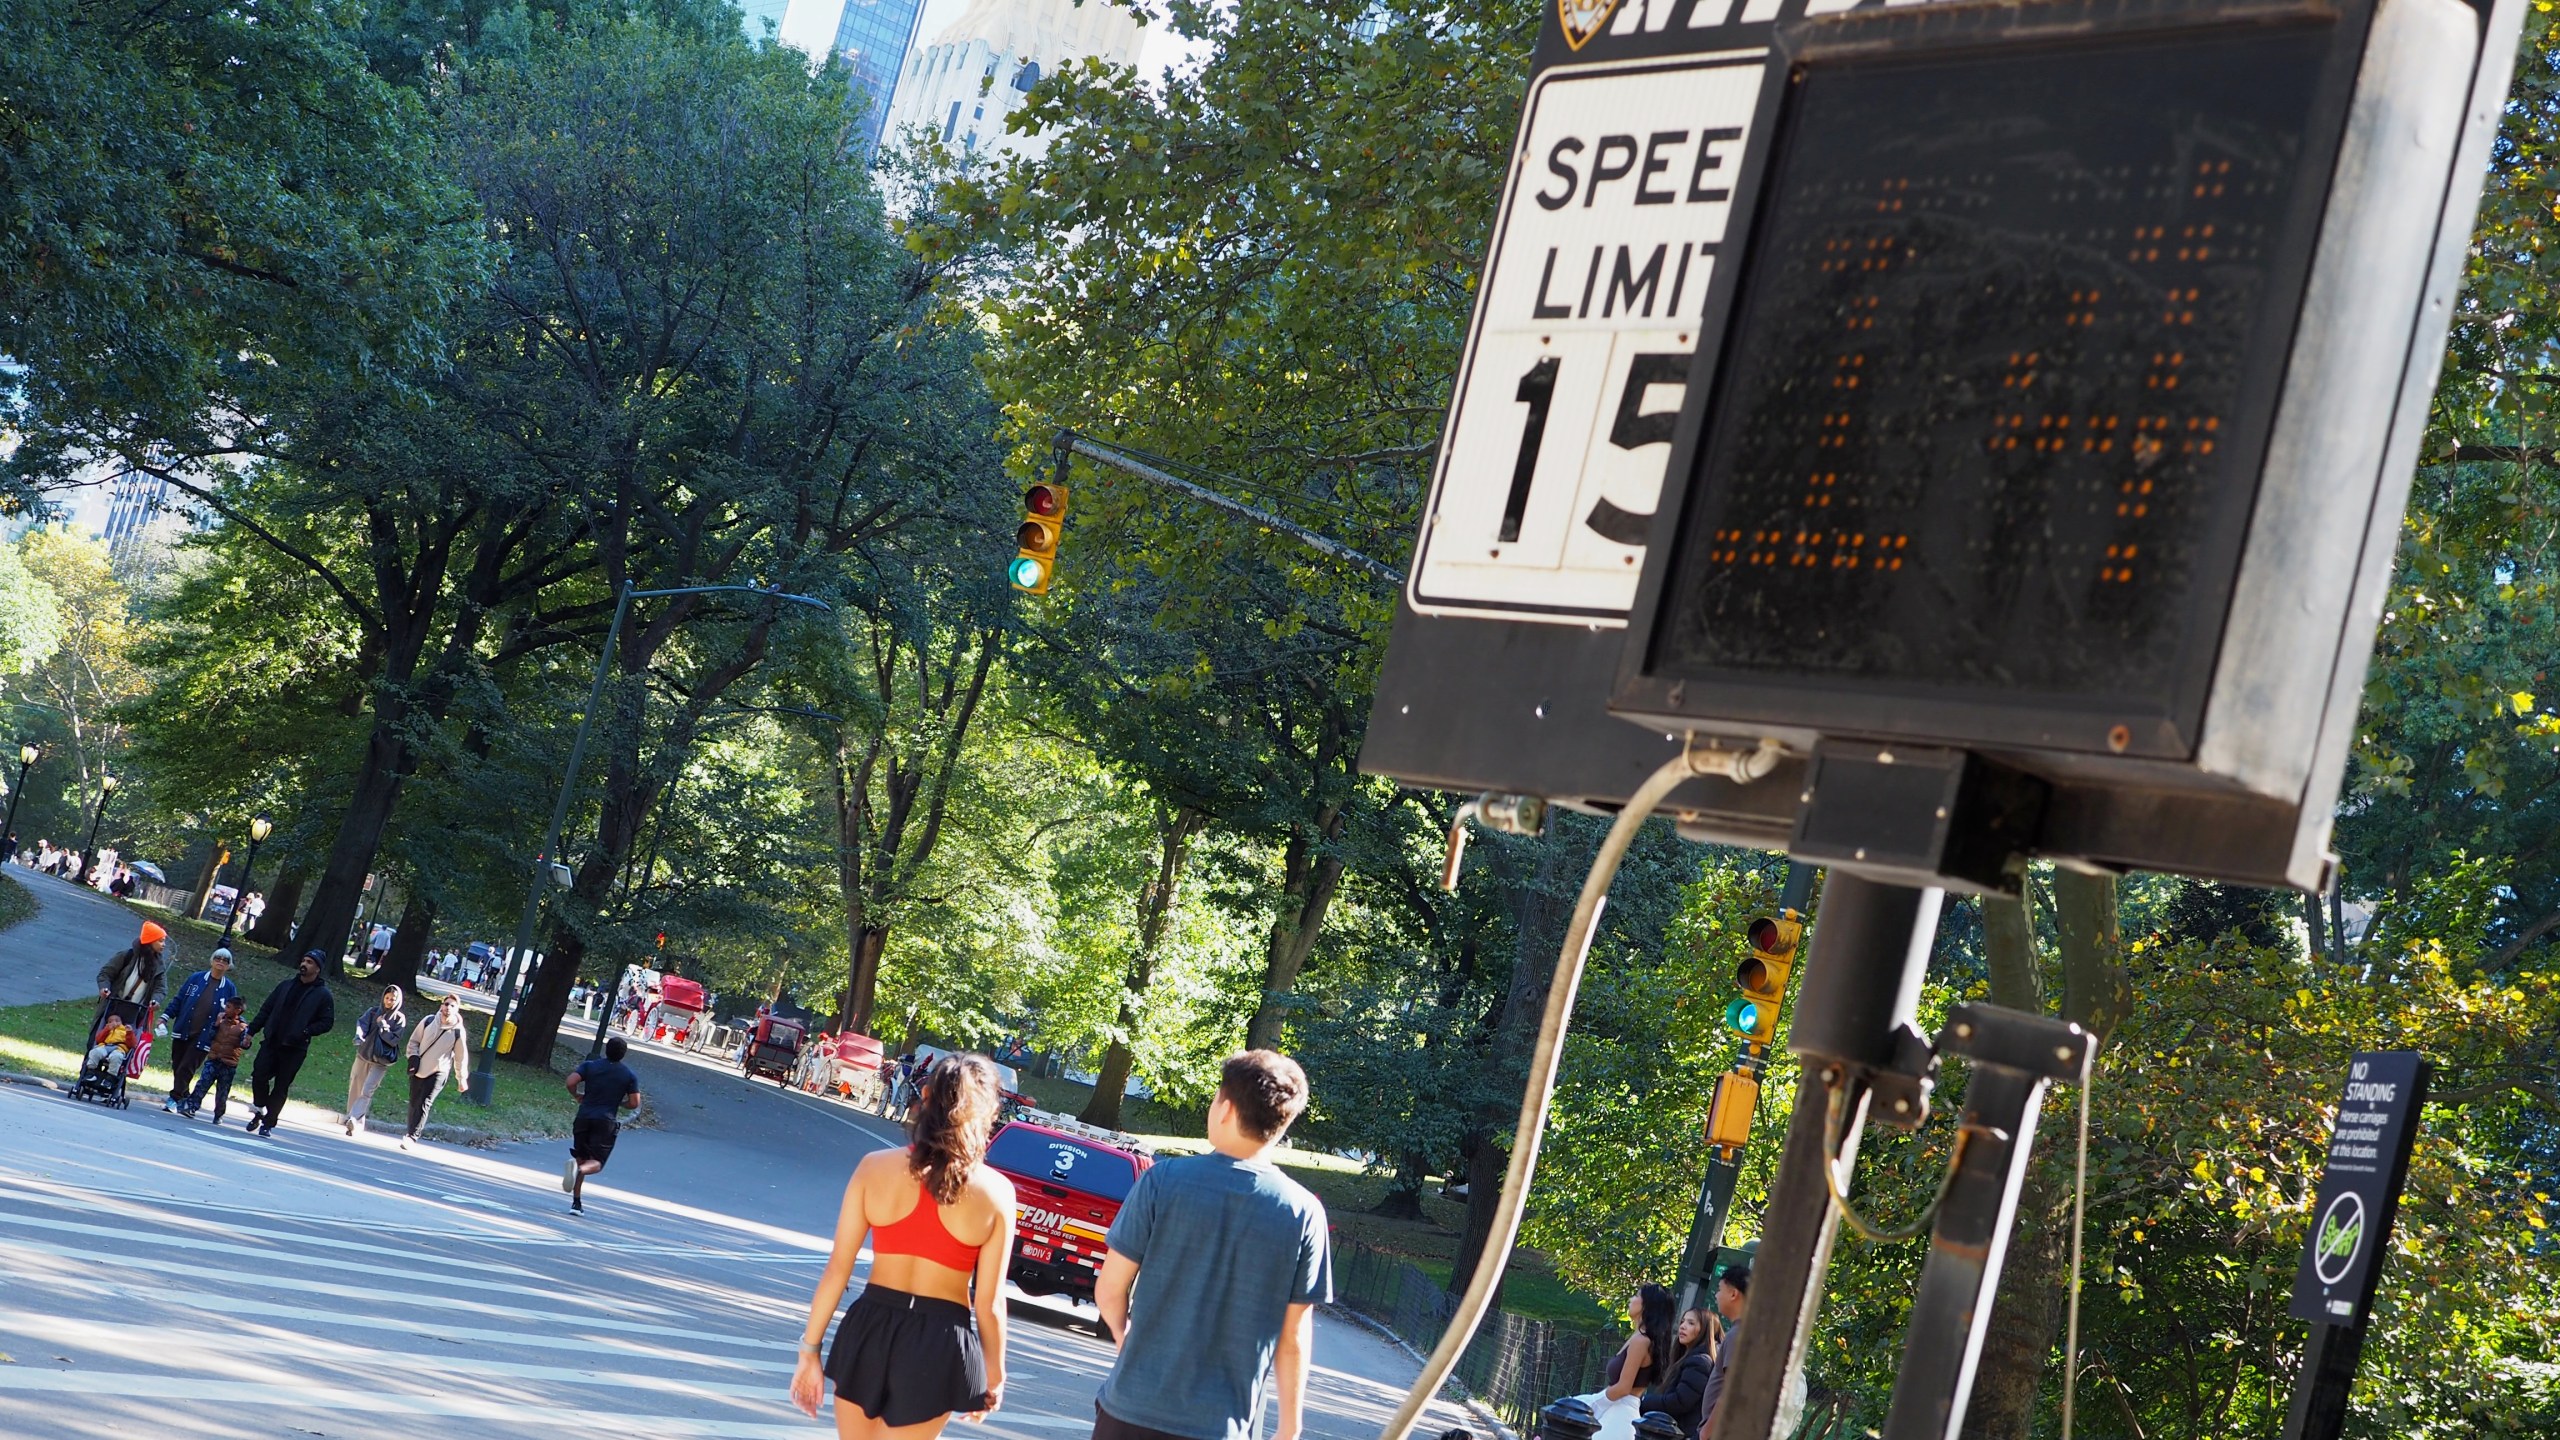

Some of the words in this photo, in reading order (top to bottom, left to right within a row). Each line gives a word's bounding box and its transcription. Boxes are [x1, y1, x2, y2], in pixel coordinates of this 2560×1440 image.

[1535, 127, 1743, 211] SPEE
[1712, 161, 2230, 582] 14
[1497, 353, 1697, 546] 15
[2350, 1062, 2369, 1081] NO
[2345, 1082, 2396, 1102] STANDING
[2340, 1110, 2359, 1123] Horse
[2359, 1111, 2388, 1126] carriages
[2335, 1129, 2345, 1140] are
[2346, 1128, 2380, 1141] prohibited
[1048, 1143, 1088, 1159] DIVISION
[1055, 1151, 1075, 1170] 3
[2331, 1146, 2339, 1157] at
[2339, 1144, 2351, 1157] this
[2352, 1144, 2377, 1158] location.
[1021, 1205, 1071, 1231] FDNY
[1017, 1220, 1033, 1228] KEEP
[1033, 1225, 1050, 1233] BACK
[1050, 1229, 1062, 1237] 200
[1062, 1232, 1077, 1241] FEET
[1032, 1247, 1046, 1258] DIV
[1046, 1251, 1052, 1261] 3
